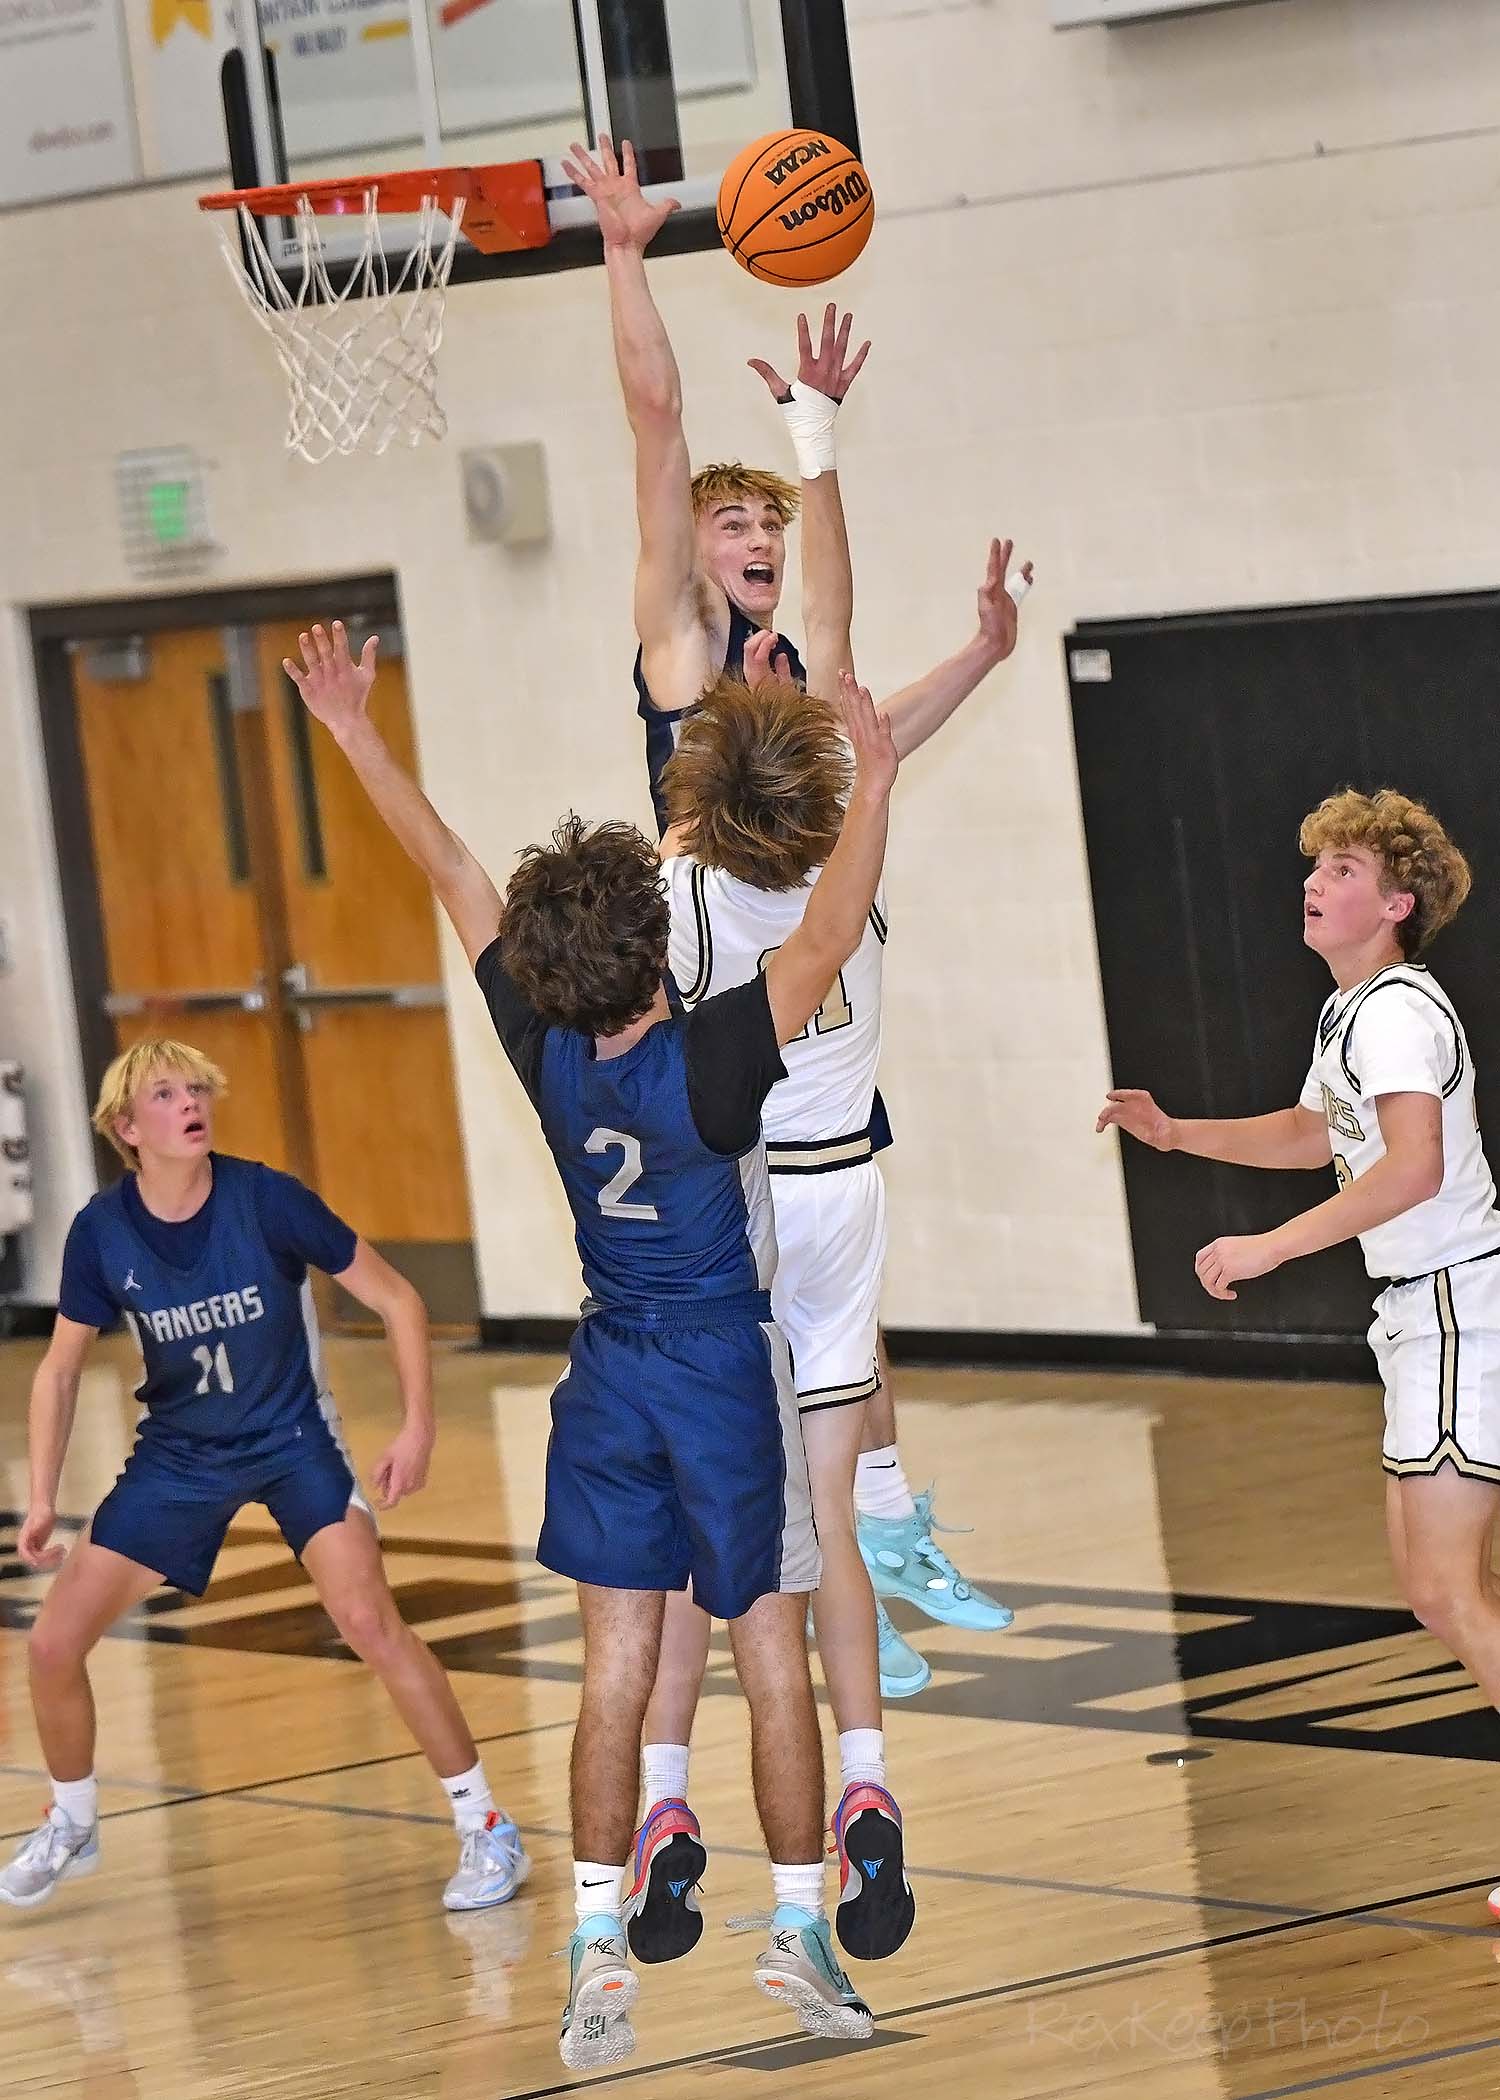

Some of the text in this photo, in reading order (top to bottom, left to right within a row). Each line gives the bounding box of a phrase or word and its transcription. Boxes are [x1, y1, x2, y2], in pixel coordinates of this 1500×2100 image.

[764, 139, 832, 186] NCAA
[778, 170, 868, 231] Wilson
[583, 1127, 659, 1221] 2
